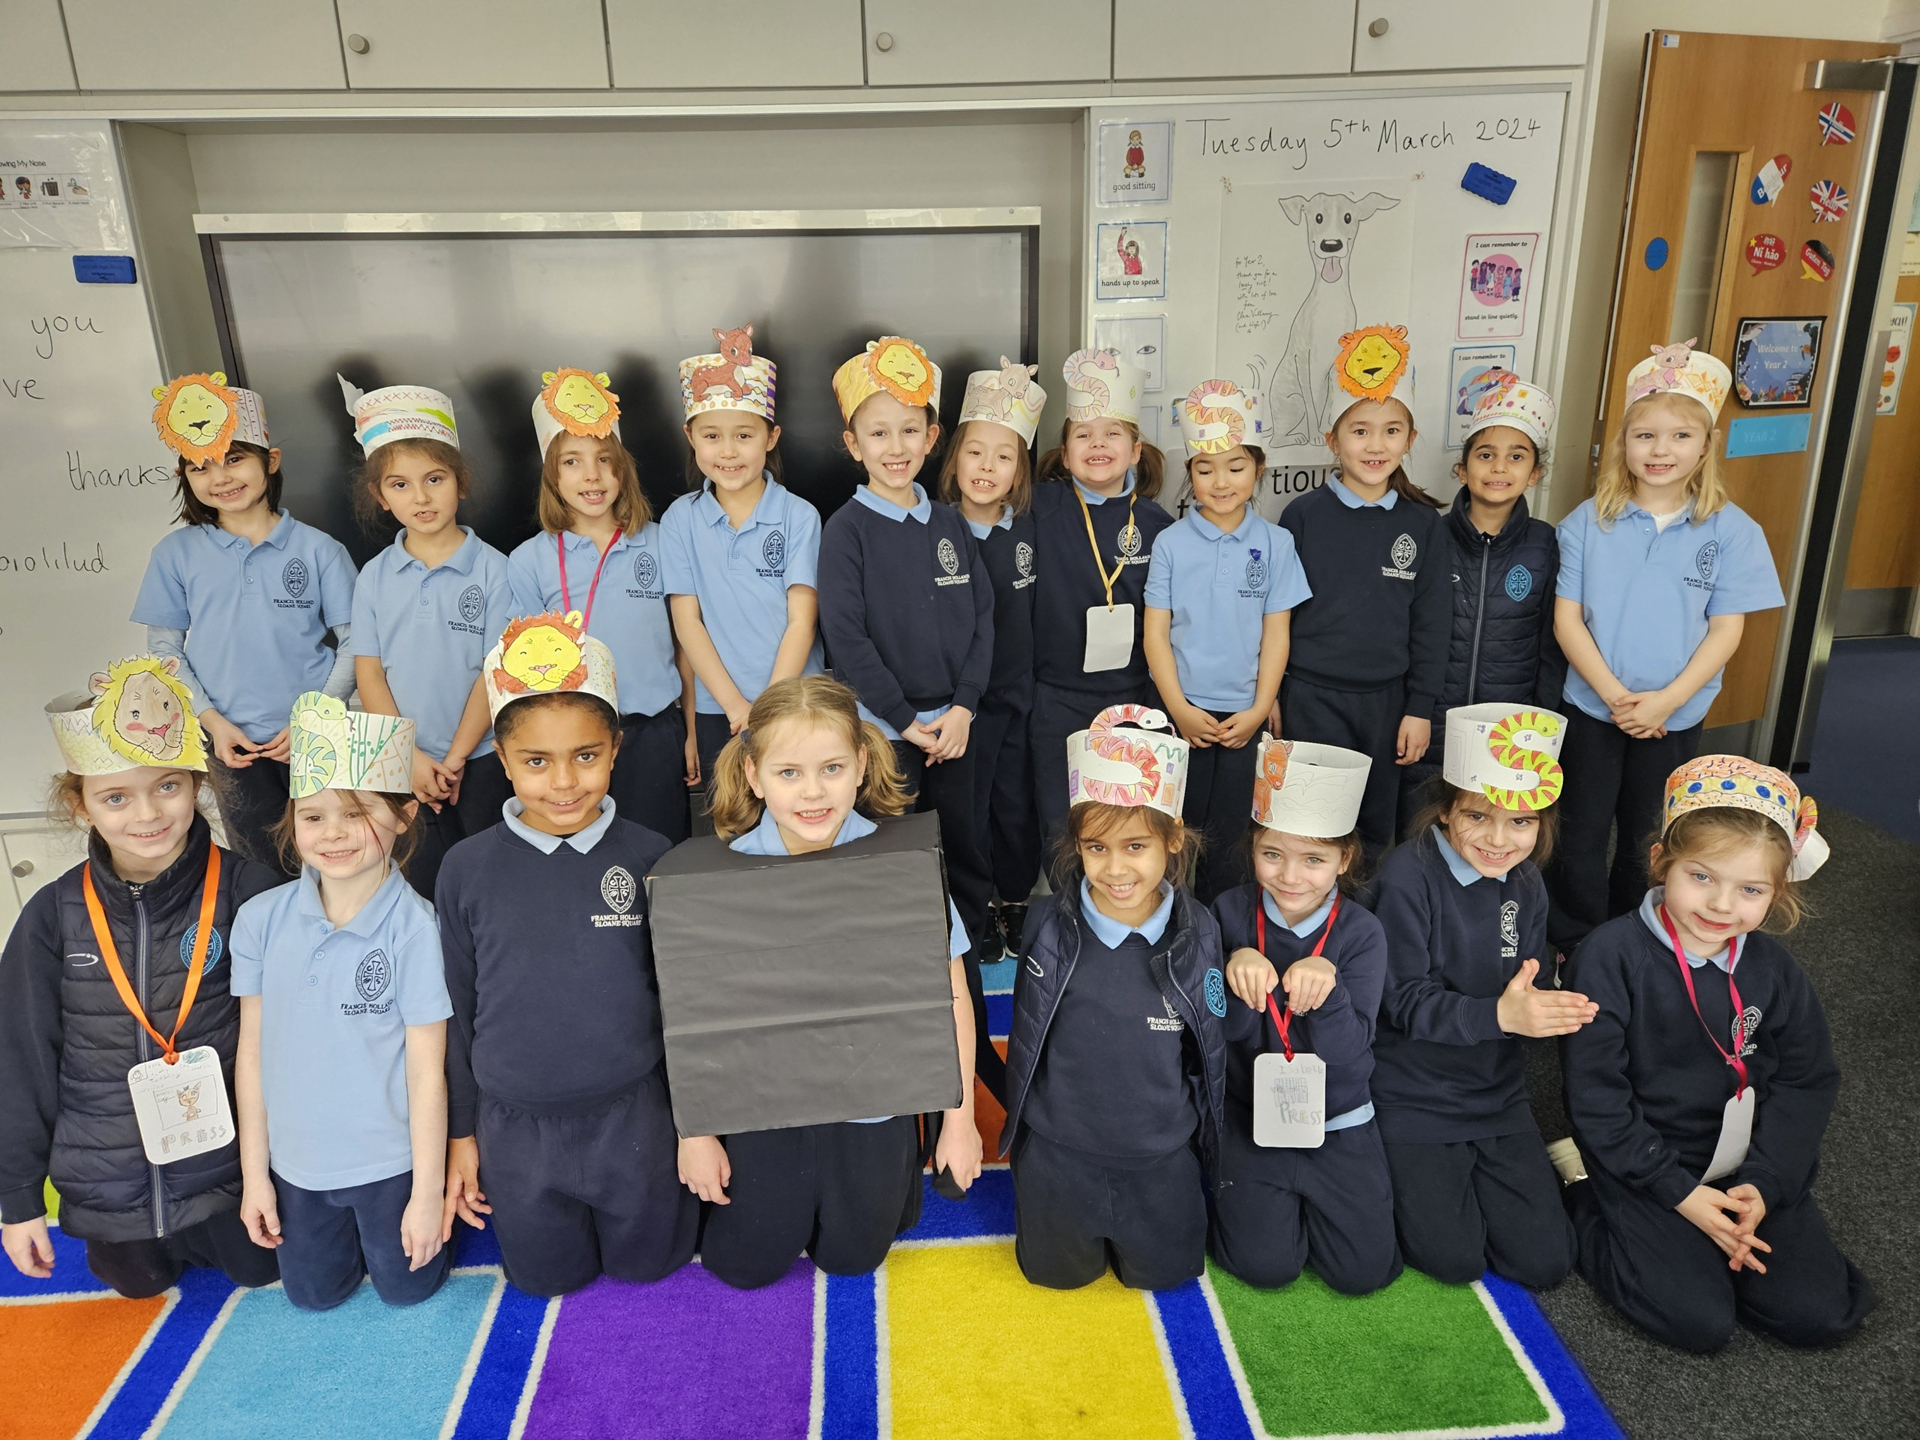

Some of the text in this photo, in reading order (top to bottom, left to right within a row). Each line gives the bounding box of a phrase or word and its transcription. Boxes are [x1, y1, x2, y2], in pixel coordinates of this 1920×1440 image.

[1185, 118, 1307, 170] Tuesday
[1377, 119, 1454, 153] March
[1476, 117, 1541, 141] 2024
[17, 160, 27, 168] My
[1113, 182, 1156, 193] good sitting
[1805, 247, 1831, 277] Guten Tag
[1123, 280, 1131, 288] up
[1141, 278, 1160, 287] speak
[31, 315, 104, 360] you
[1757, 344, 1798, 354] Welcome to
[1764, 360, 1788, 370] Year 2
[1743, 428, 1777, 443] YEAR 2
[1271, 465, 1342, 495] tiou
[590, 914, 618, 922] FRANCIS
[594, 920, 621, 928] SLOANE
[368, 999, 393, 1009] HOLLAND
[369, 1007, 391, 1015] SQUARE
[161, 1125, 227, 1155] PRESS
